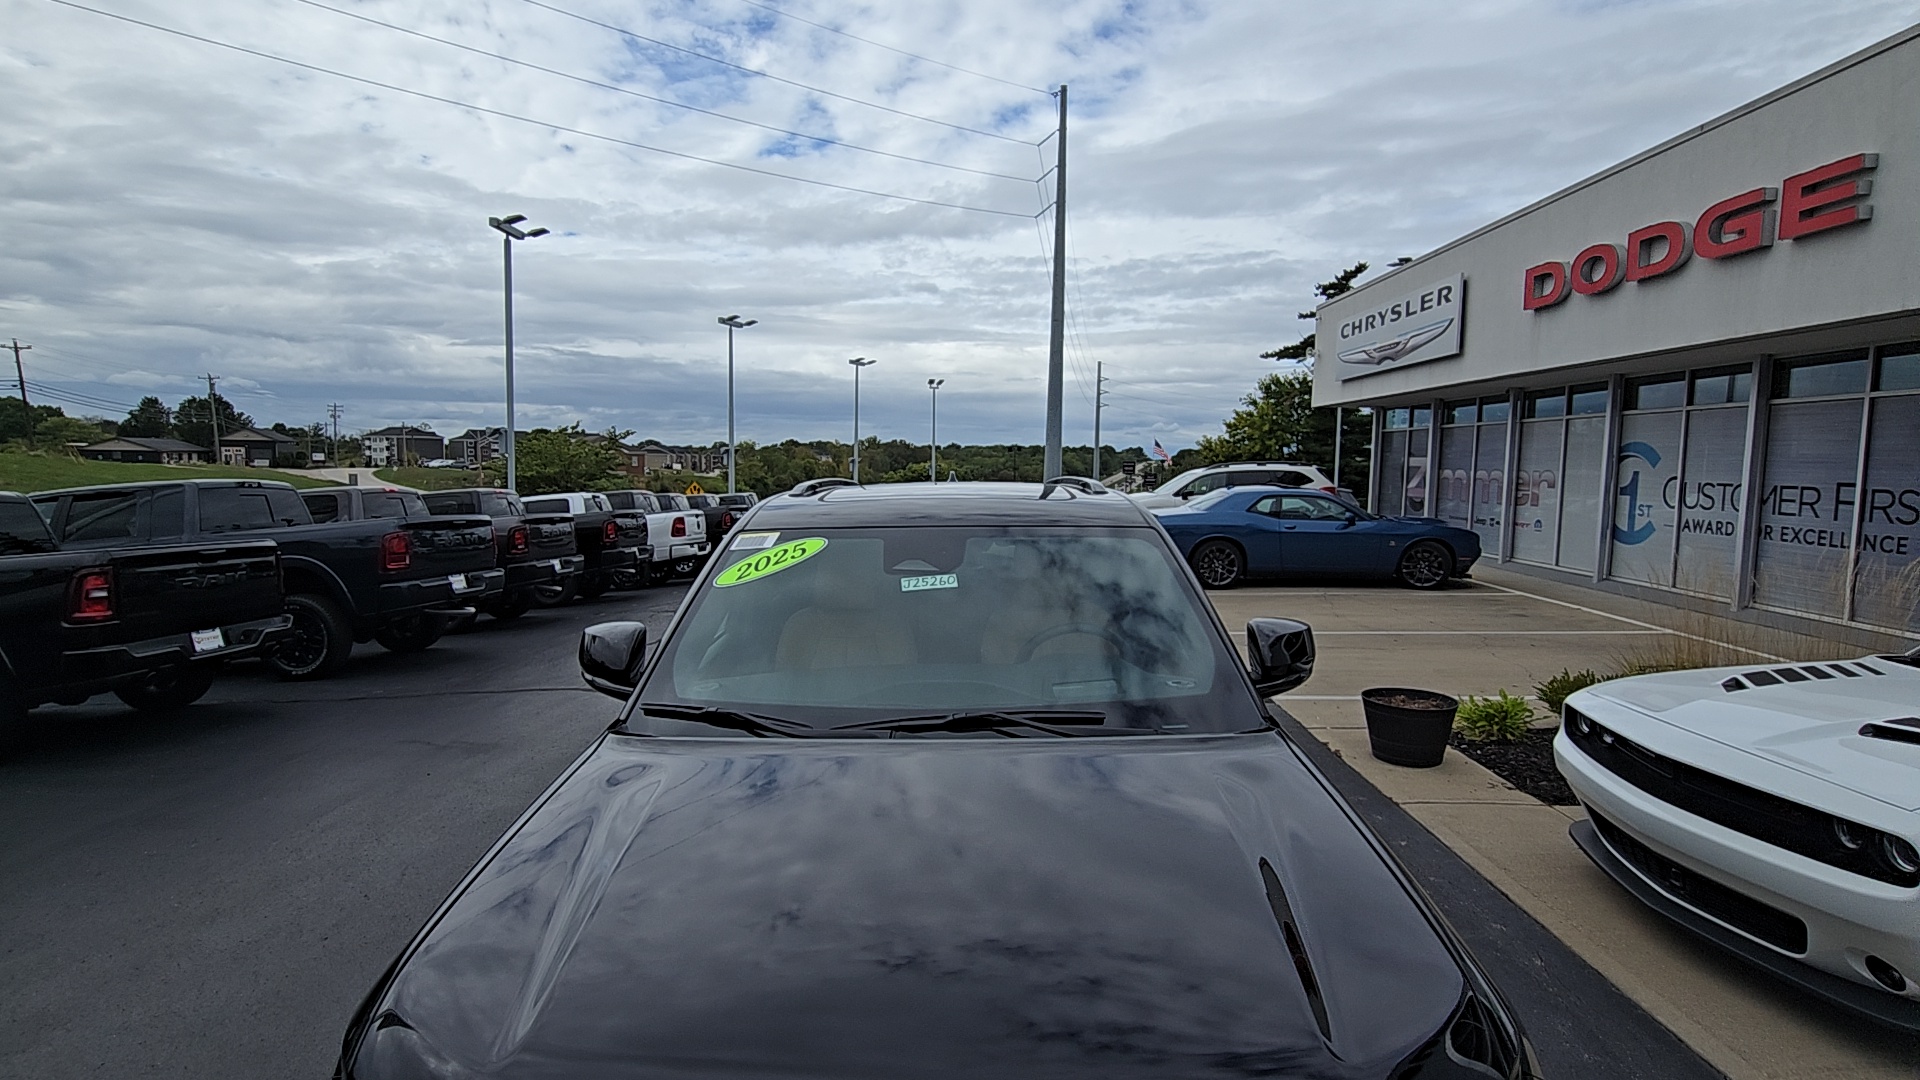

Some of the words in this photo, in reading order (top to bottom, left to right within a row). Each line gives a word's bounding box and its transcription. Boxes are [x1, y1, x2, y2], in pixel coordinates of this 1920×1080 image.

[1523, 153, 1877, 310] DODGE
[1341, 285, 1453, 339] CHRYSLER
[1405, 456, 1554, 507] Zmmer
[433, 534, 479, 547] RAM
[1681, 518, 1736, 537] AWARD
[1780, 526, 1909, 555] EXCELLNCE
[736, 541, 807, 581] 2025
[902, 575, 956, 589] J25260
